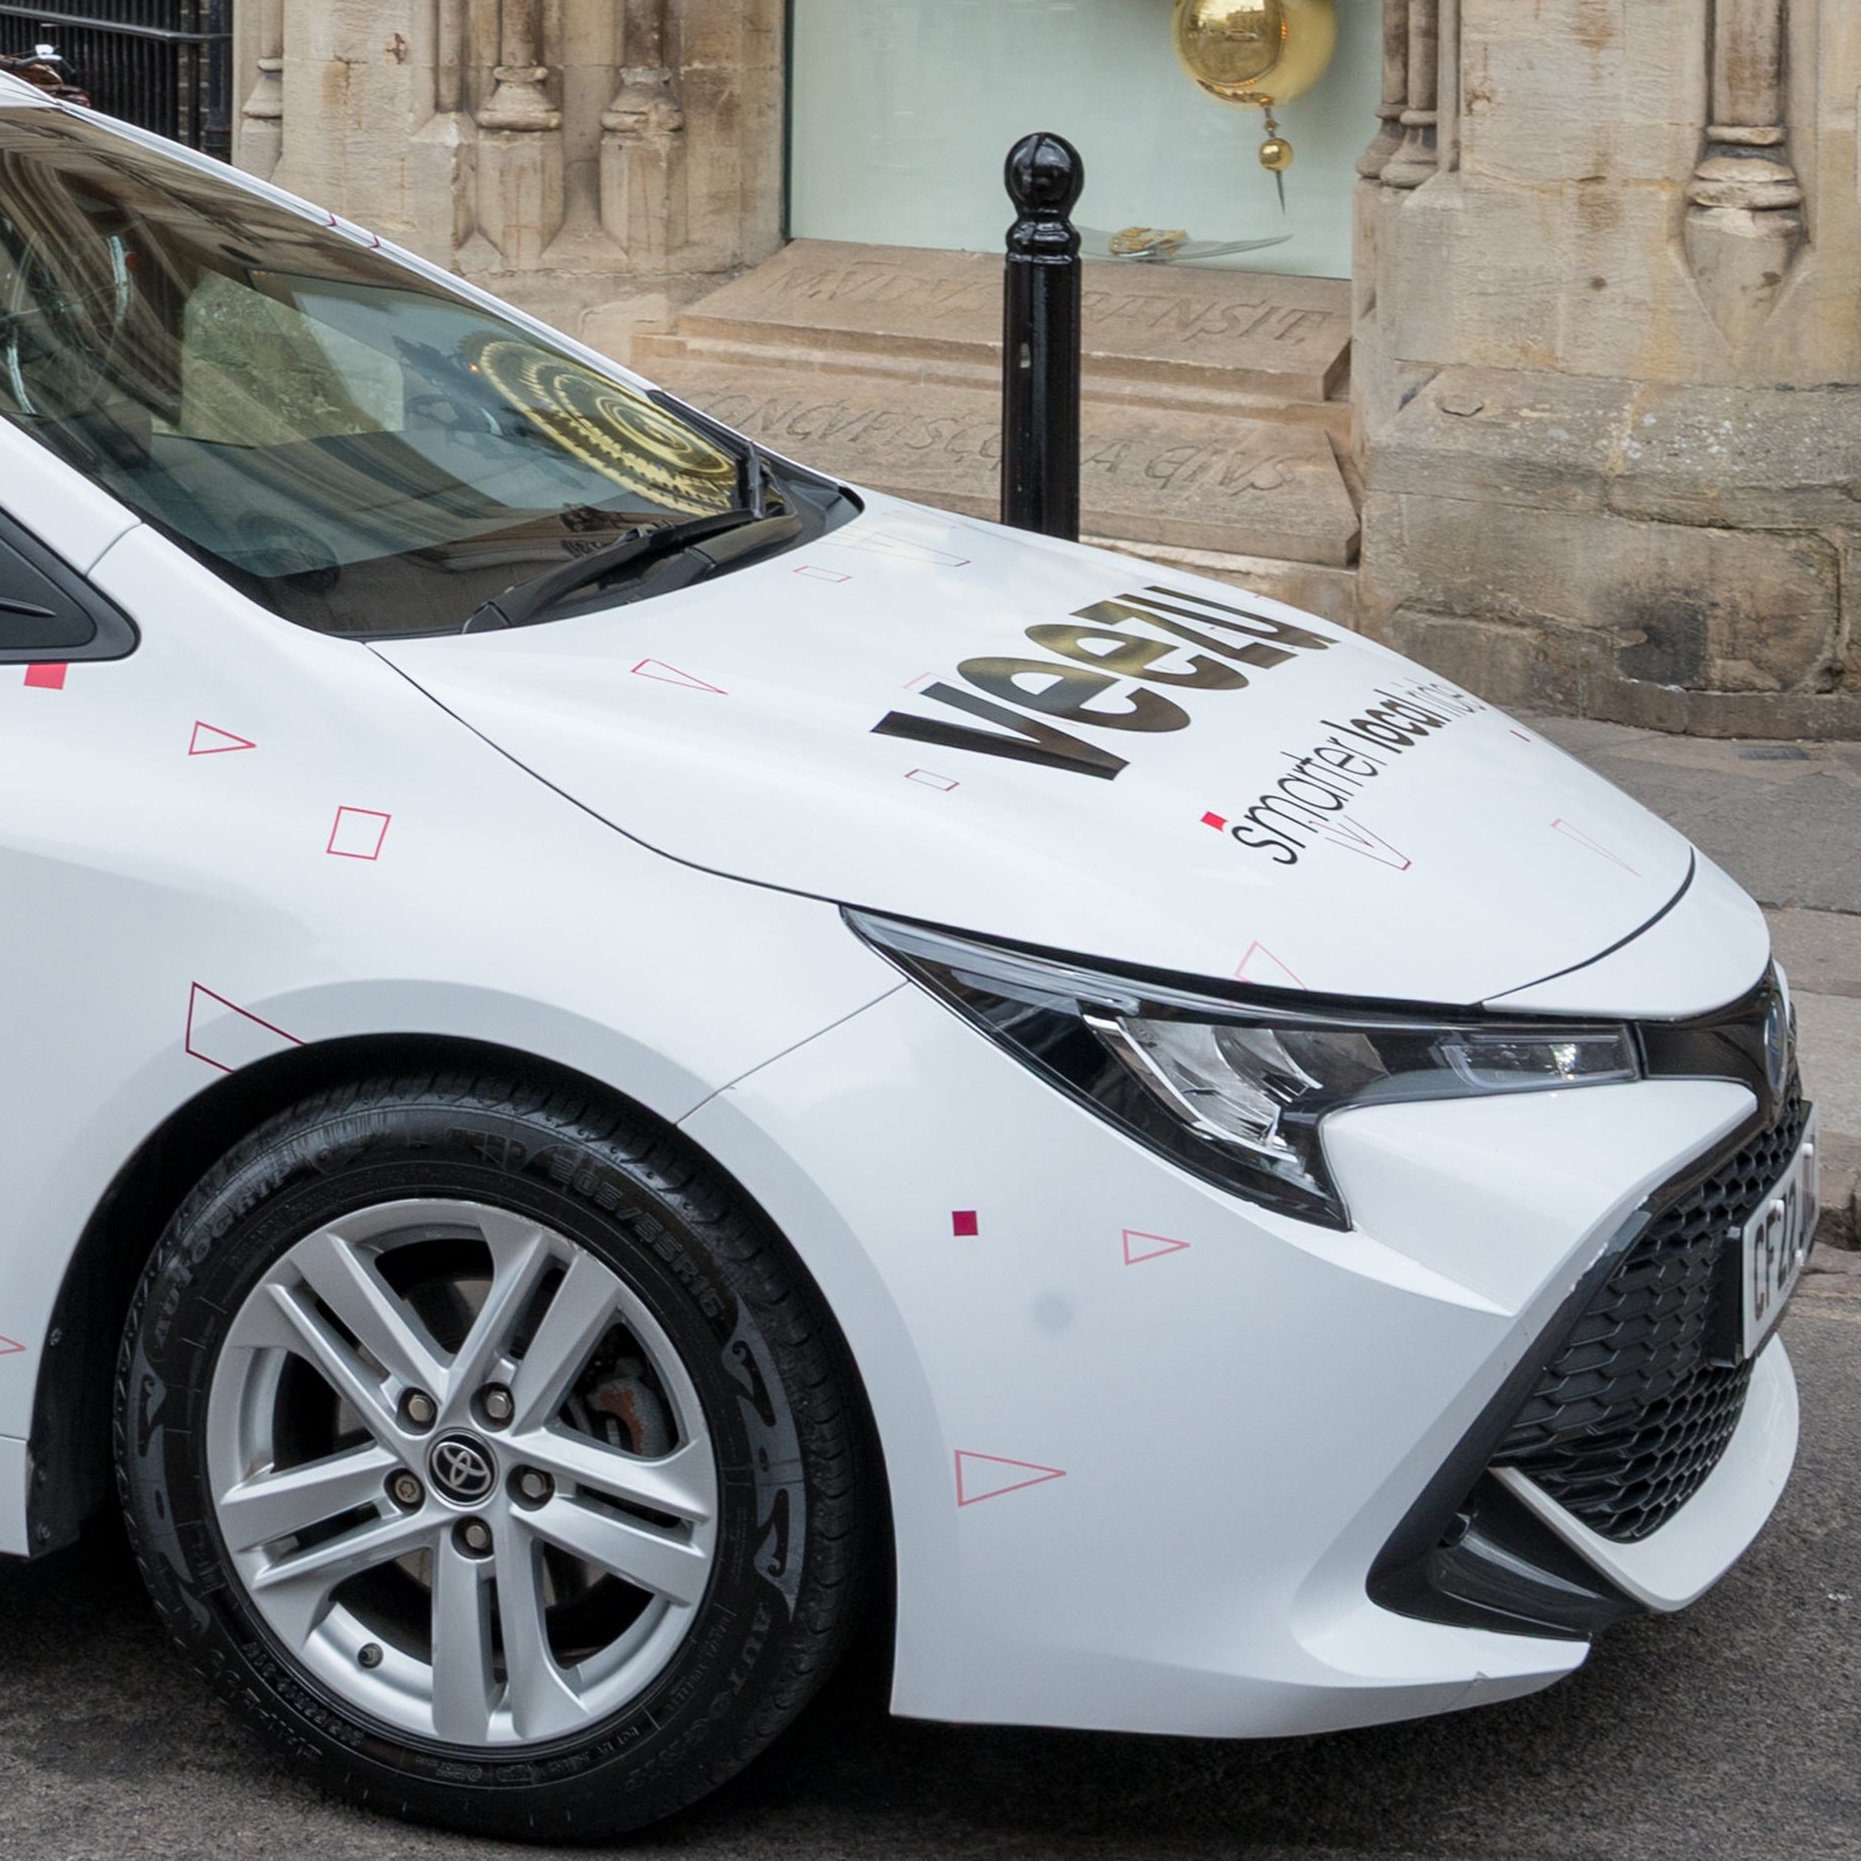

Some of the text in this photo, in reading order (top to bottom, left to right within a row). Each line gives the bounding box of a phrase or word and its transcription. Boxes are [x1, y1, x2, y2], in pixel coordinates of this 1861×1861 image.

[871, 585, 1341, 781] veezu
[1231, 736, 1388, 865] smarter
[1320, 688, 1451, 754] local
